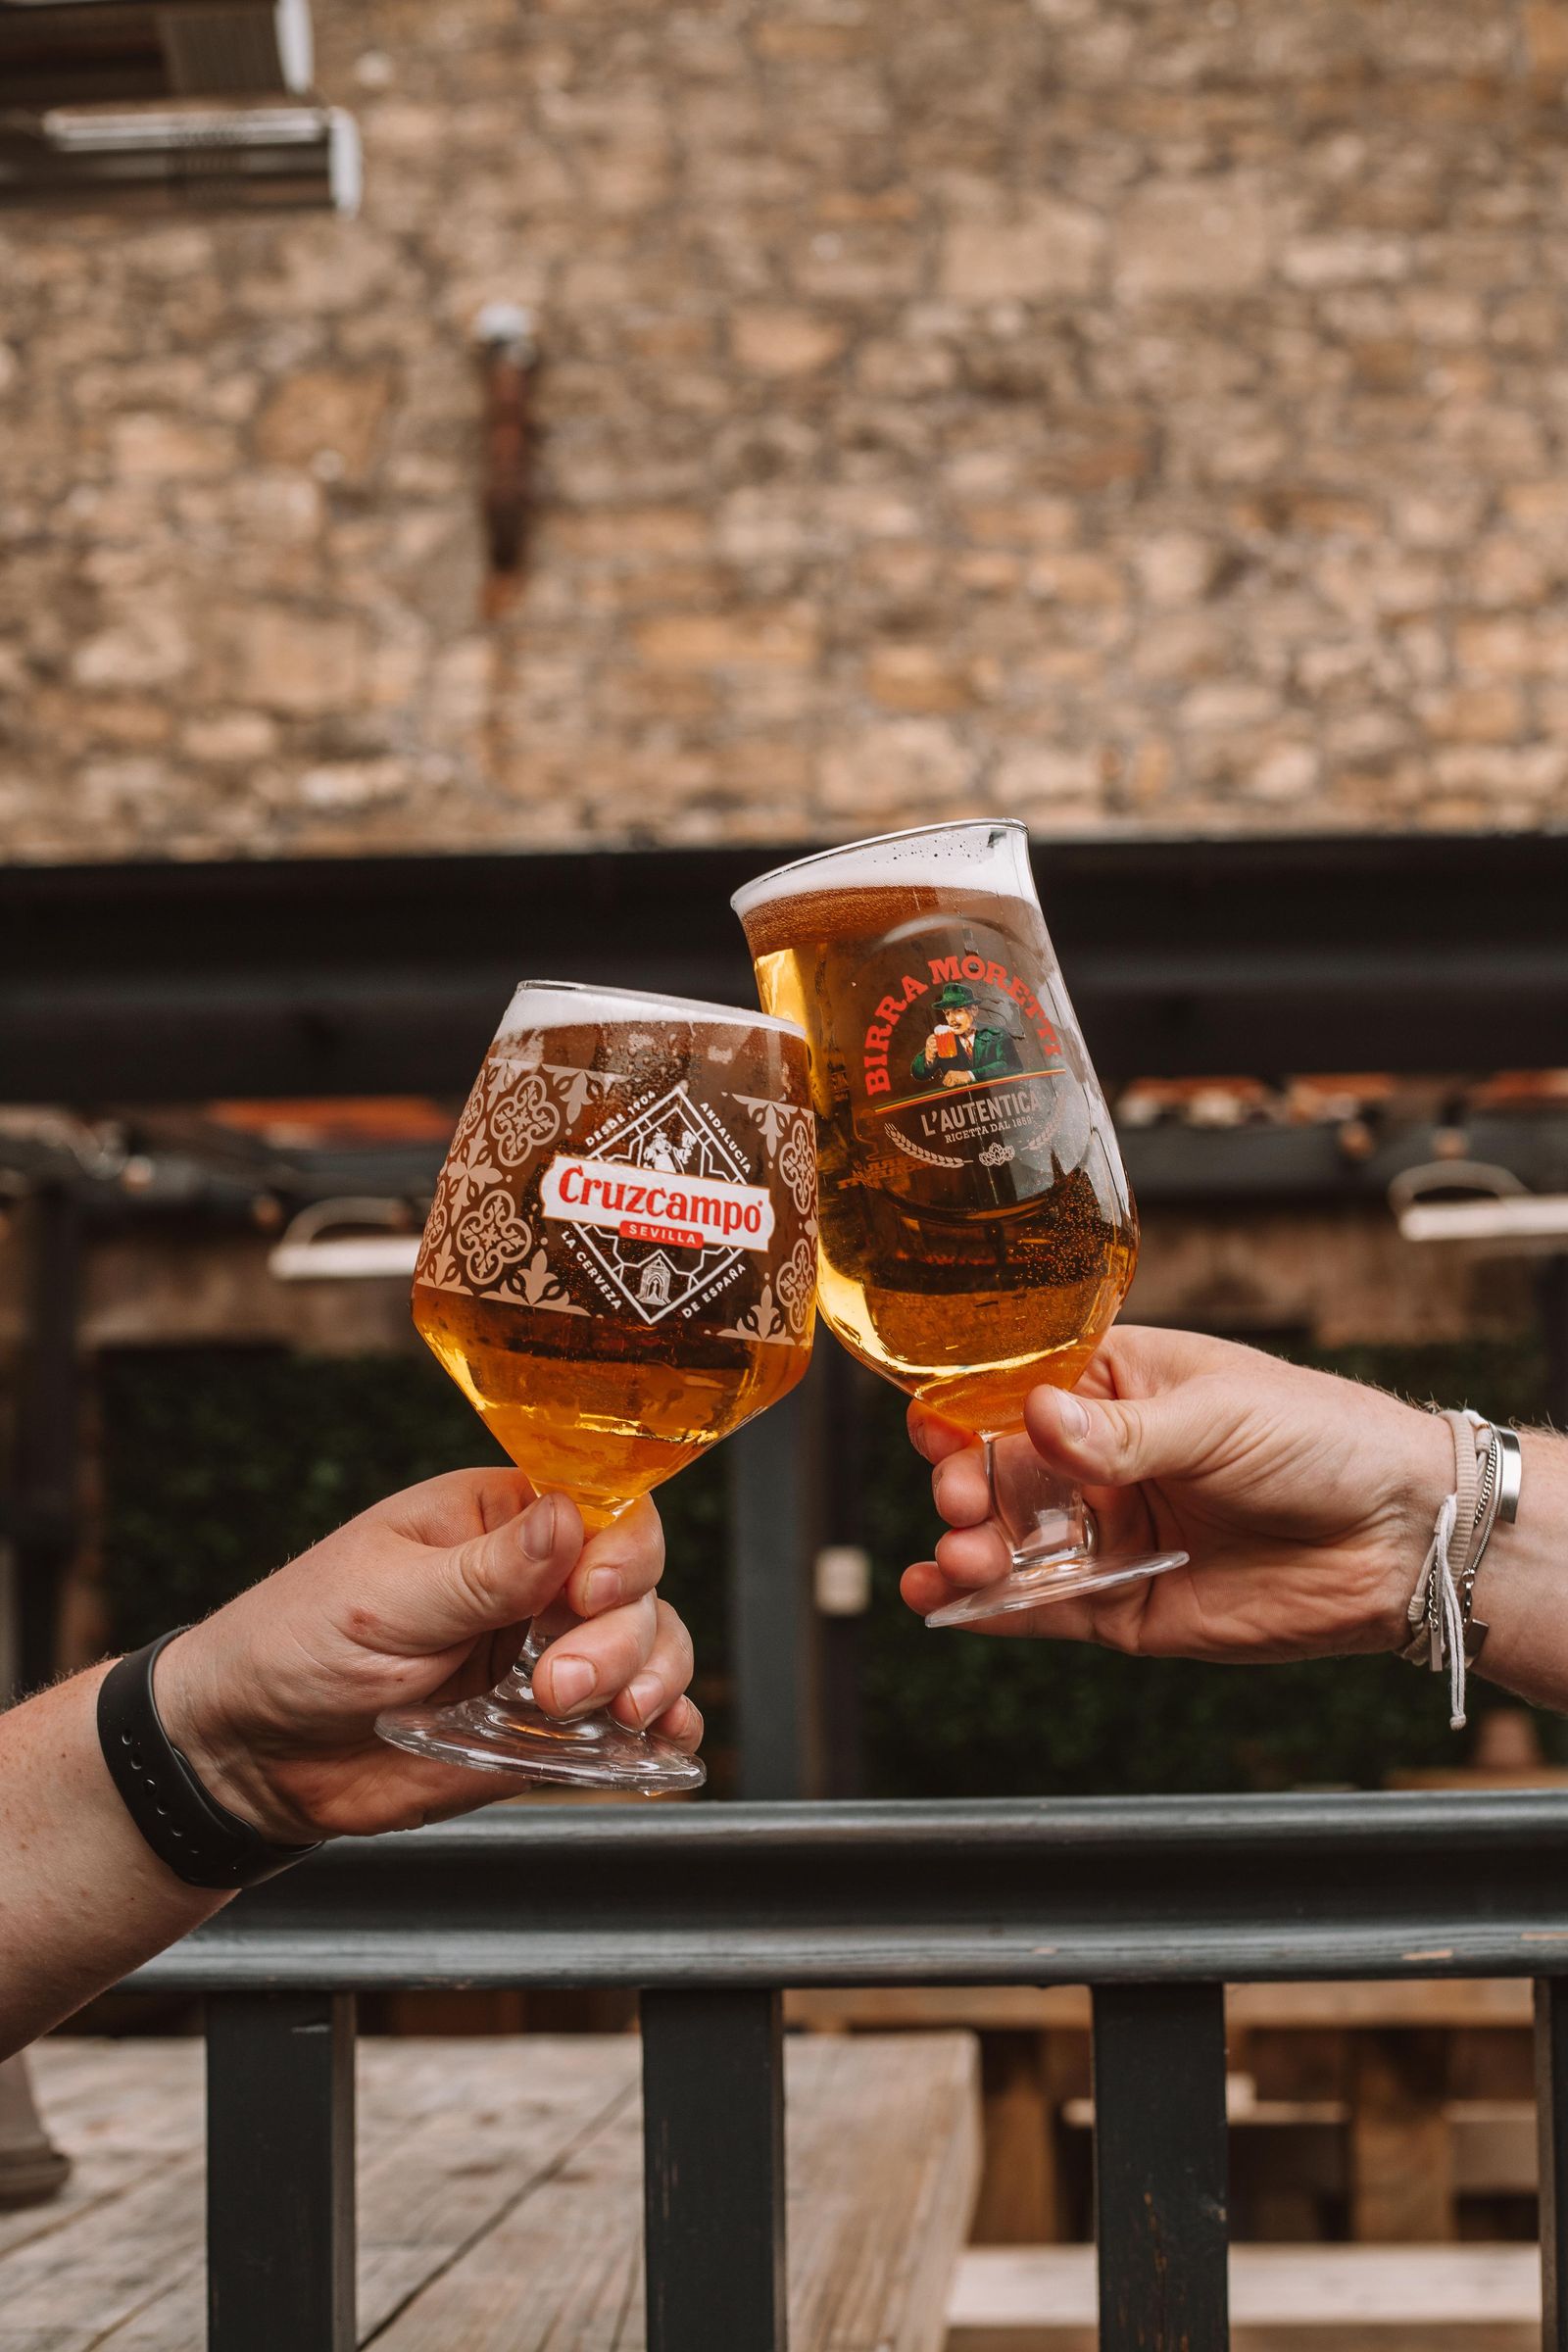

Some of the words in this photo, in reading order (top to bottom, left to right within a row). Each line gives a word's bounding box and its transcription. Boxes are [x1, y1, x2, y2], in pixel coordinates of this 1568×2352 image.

[864, 975, 928, 1096] BIRRA
[927, 956, 1061, 1055] MORETTI
[585, 1112, 625, 1148] DESDE
[627, 1090, 656, 1114] 1904
[700, 1102, 752, 1174] ANDALUCÍA
[920, 1091, 1040, 1137] L’AUTENTICA
[945, 1127, 989, 1144] RICETTA
[991, 1121, 1010, 1134] DAL
[559, 1165, 761, 1235] Cruzcampo
[628, 1224, 696, 1245] SEVILLA
[561, 1230, 576, 1250] LA
[576, 1252, 622, 1311] CERVEZA
[681, 1297, 701, 1319] DE
[704, 1263, 746, 1303] ESPAÑA
